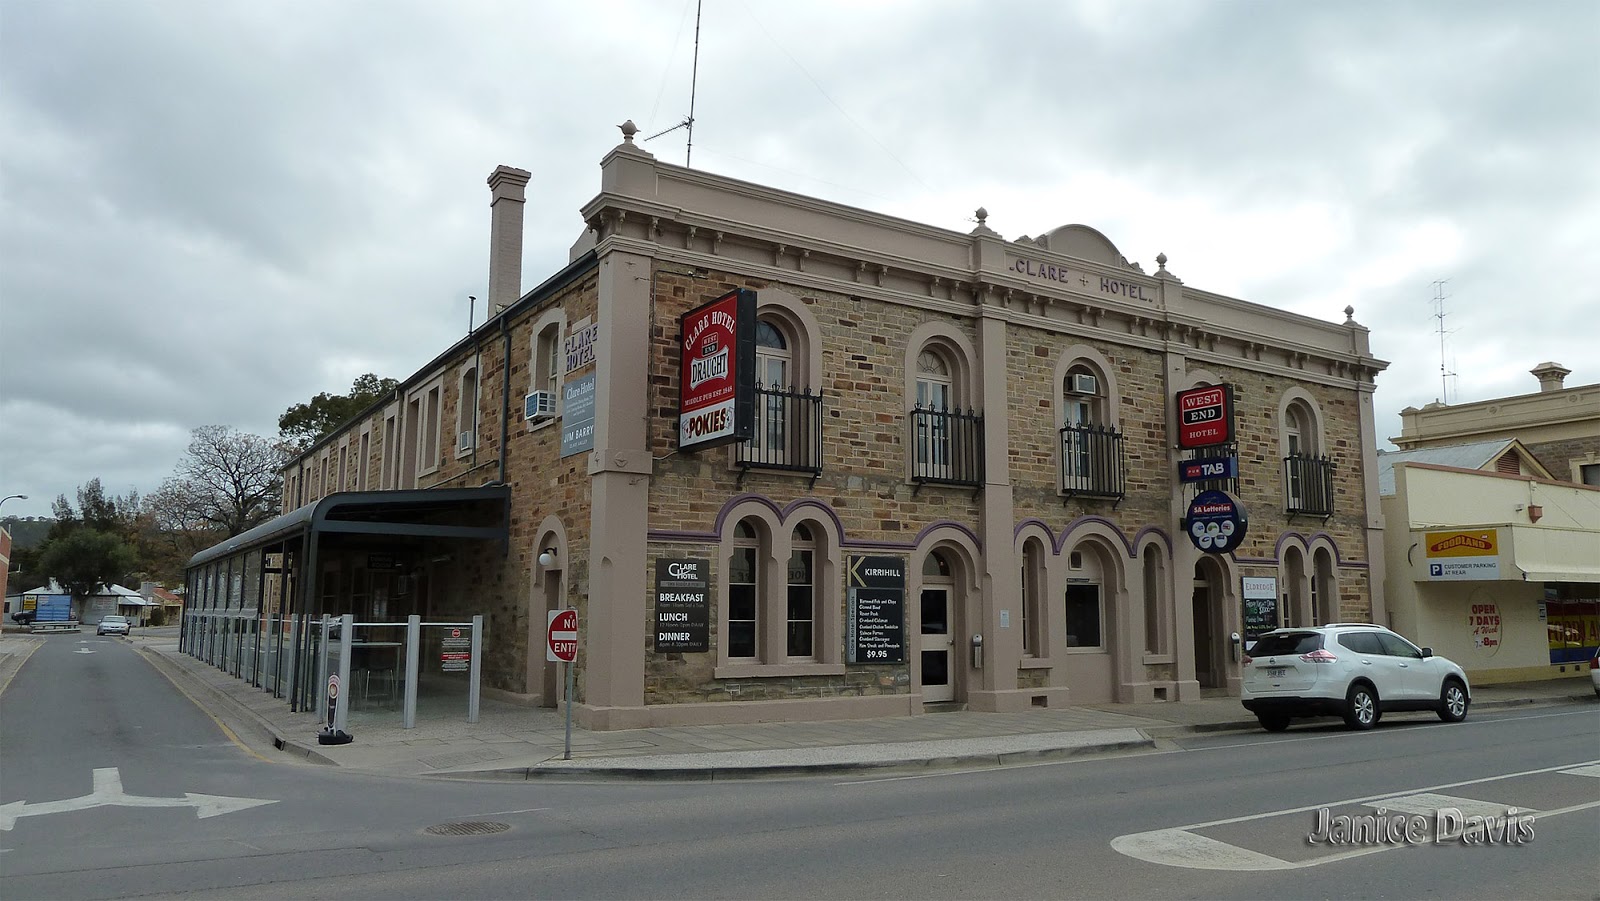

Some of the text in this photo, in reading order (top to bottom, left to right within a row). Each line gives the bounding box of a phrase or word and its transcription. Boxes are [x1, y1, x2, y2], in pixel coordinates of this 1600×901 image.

[685, 311, 735, 350] CLARE HOTEL
[565, 325, 598, 355] CLARE
[703, 334, 717, 344] WEST
[704, 345, 716, 354] END
[566, 344, 595, 372] HOTEL
[692, 353, 727, 383] DRAUGHT
[567, 377, 595, 400] Clare Hotel
[684, 395, 703, 406] MIDDLE
[703, 392, 712, 400] PUB
[1186, 393, 1219, 407] WEST
[1191, 408, 1216, 421] END
[689, 408, 727, 438] POKIES
[575, 424, 594, 440] BARRY
[1189, 428, 1219, 439] HOTEL
[1201, 462, 1224, 476] TAB
[1203, 504, 1230, 513] Lotteries
[1437, 536, 1485, 550] FOODLAND
[668, 563, 697, 577] CLARE
[677, 569, 698, 579] HOTEL
[865, 568, 900, 577] KIRRIHILL
[1245, 582, 1274, 591] ELDREDGE
[660, 593, 704, 602] BREAKFAST
[1472, 604, 1495, 614] OPEN
[659, 613, 688, 621] LUNCH
[1469, 616, 1500, 626] 7 DAYS
[659, 632, 690, 641] DINNER
[866, 650, 888, 658] $9.95
